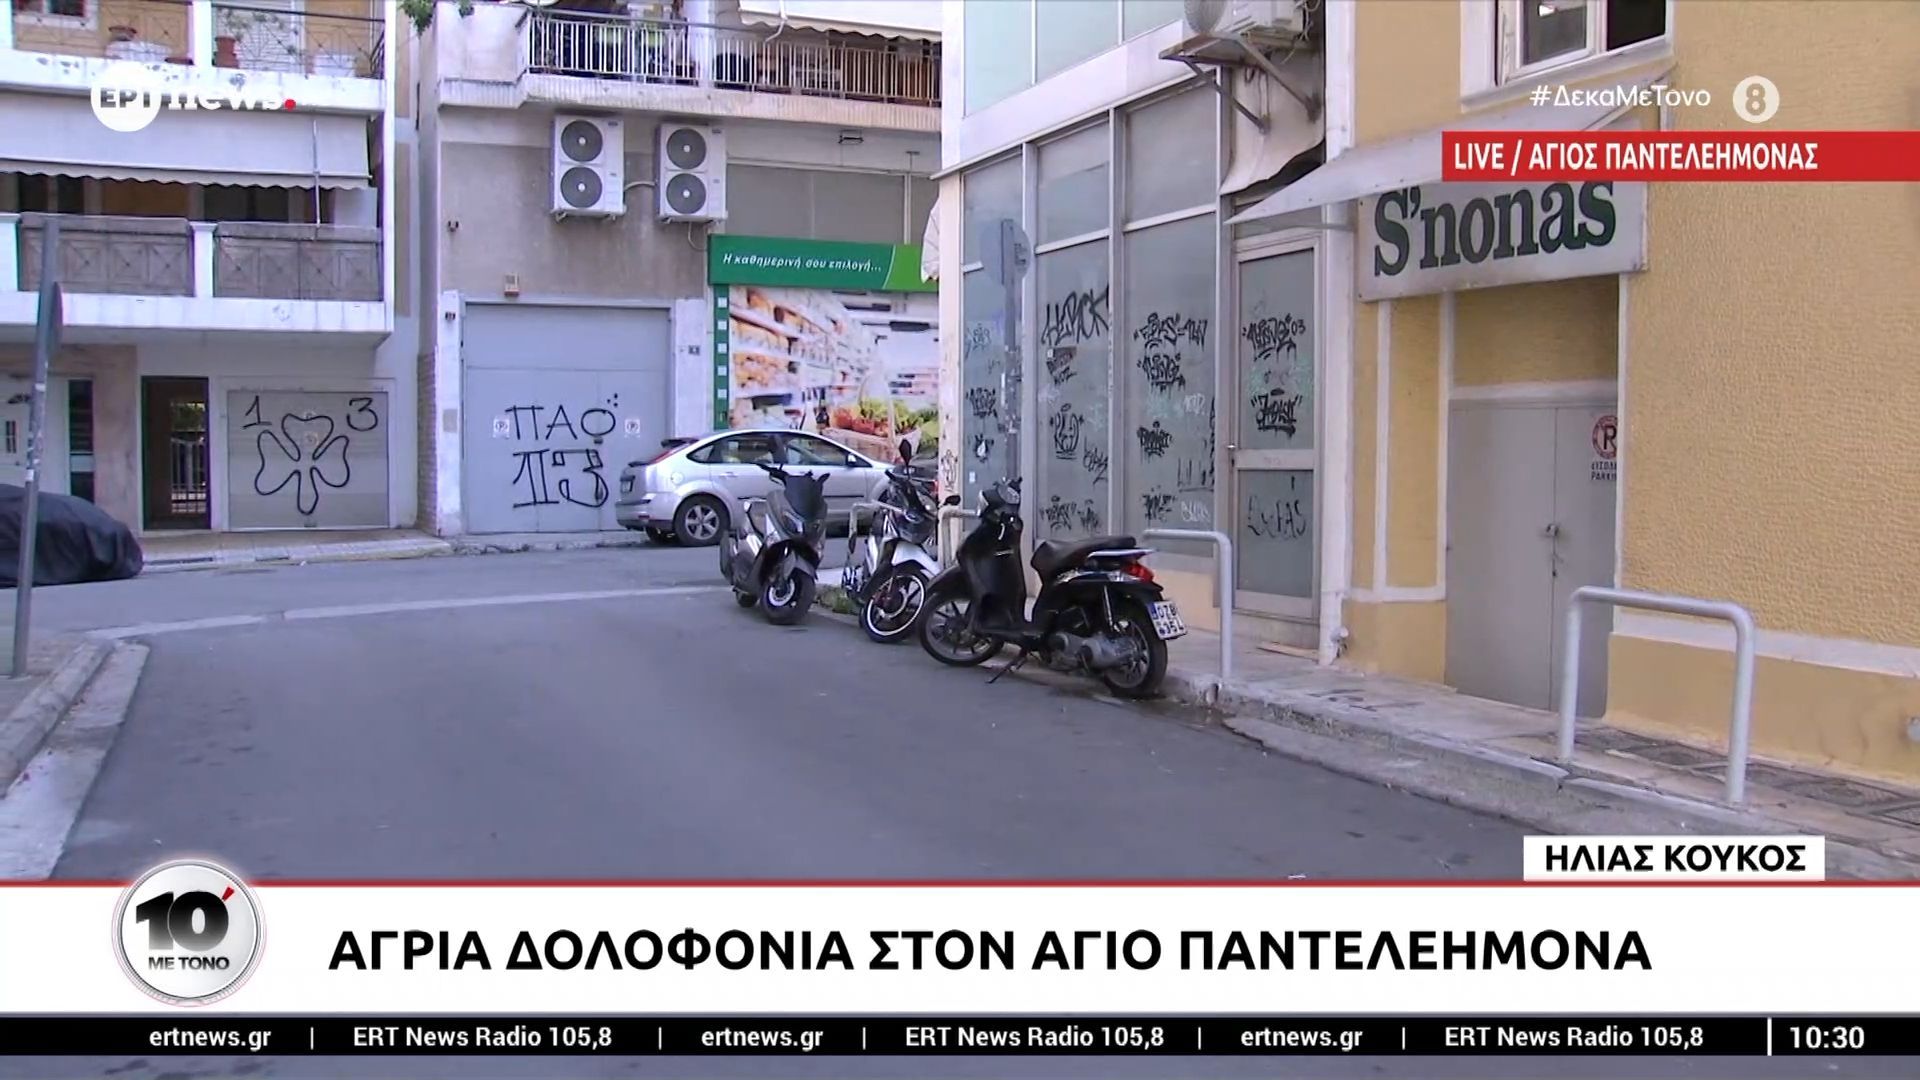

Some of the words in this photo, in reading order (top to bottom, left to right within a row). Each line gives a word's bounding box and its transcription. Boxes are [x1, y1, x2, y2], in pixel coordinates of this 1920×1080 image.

[723, 253, 733, 265] Η
[733, 254, 801, 269] καθημερινή
[805, 259, 827, 269] σου
[346, 397, 378, 431] 3
